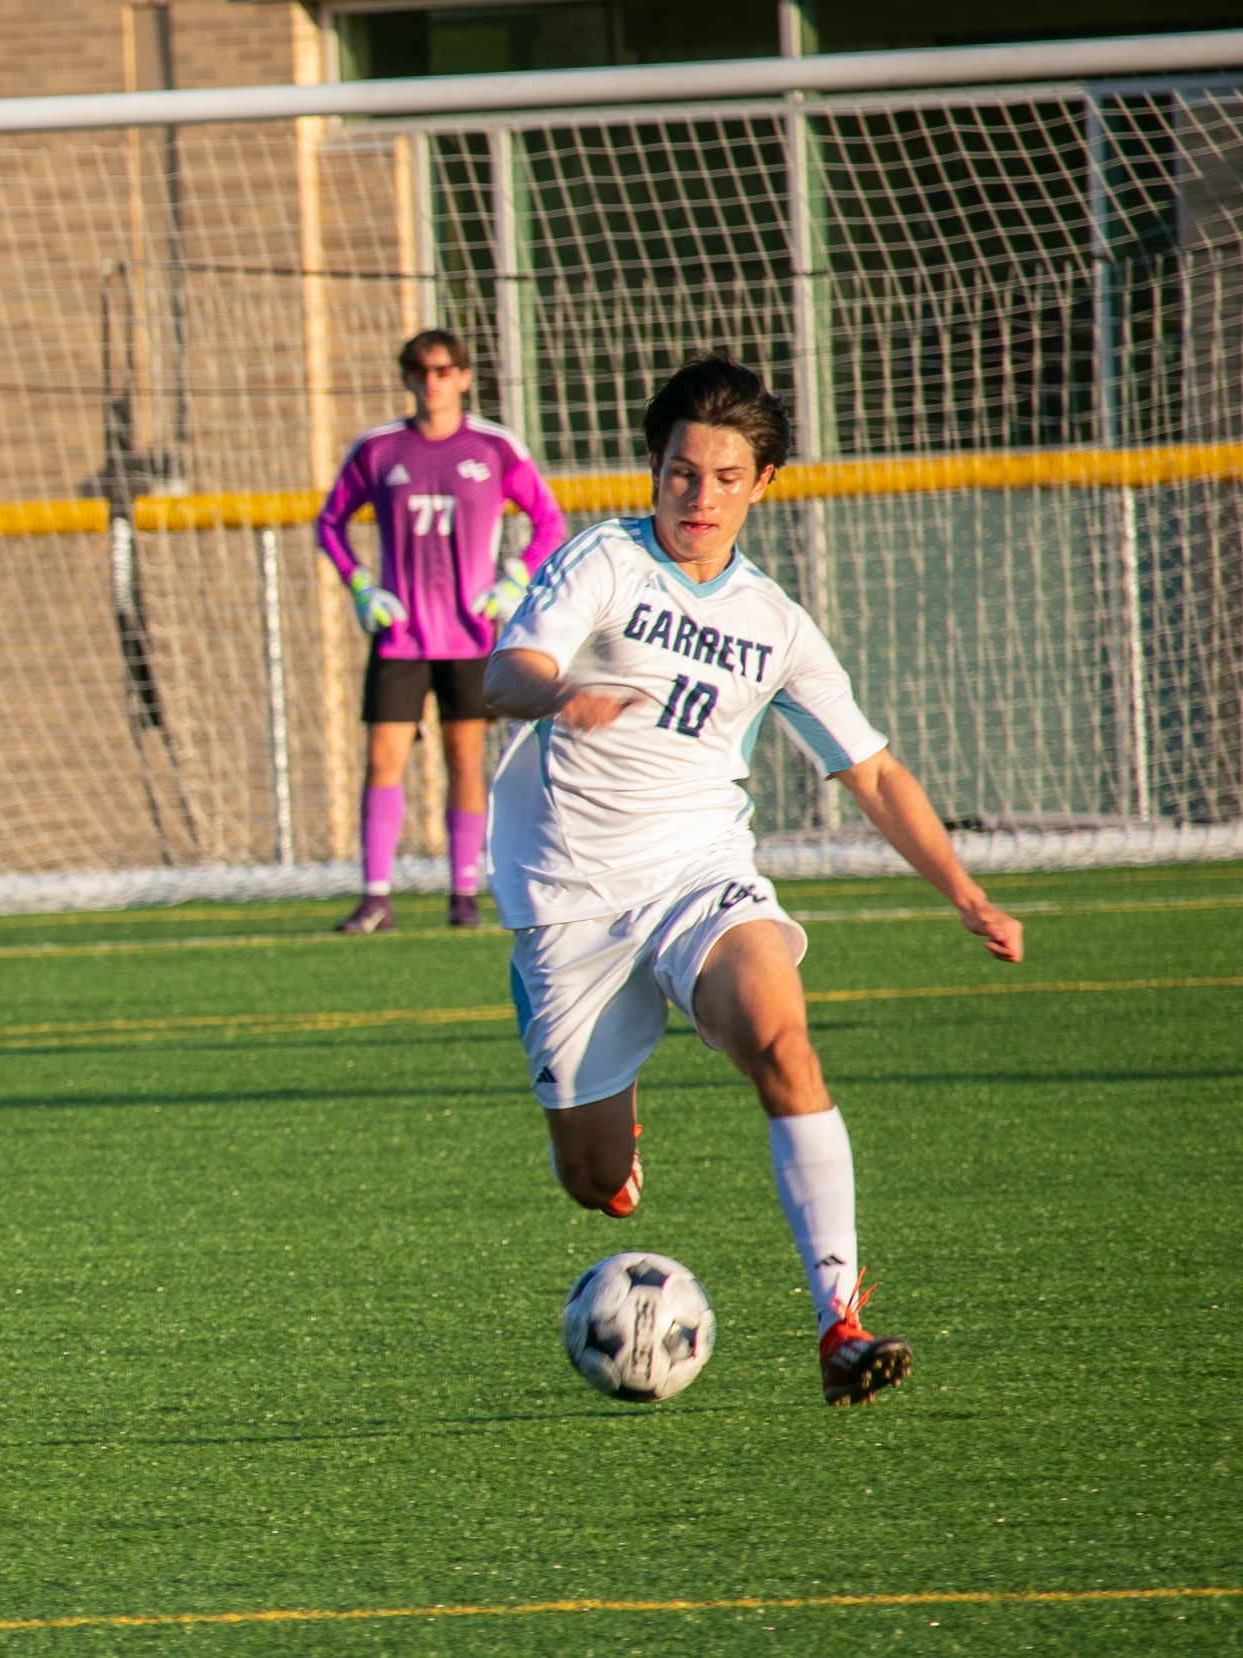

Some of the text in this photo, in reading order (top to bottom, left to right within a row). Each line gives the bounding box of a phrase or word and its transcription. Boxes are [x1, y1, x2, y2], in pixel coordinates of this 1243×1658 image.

[408, 494, 455, 536] 77
[623, 602, 773, 683] GARRETT
[655, 673, 719, 738] 10
